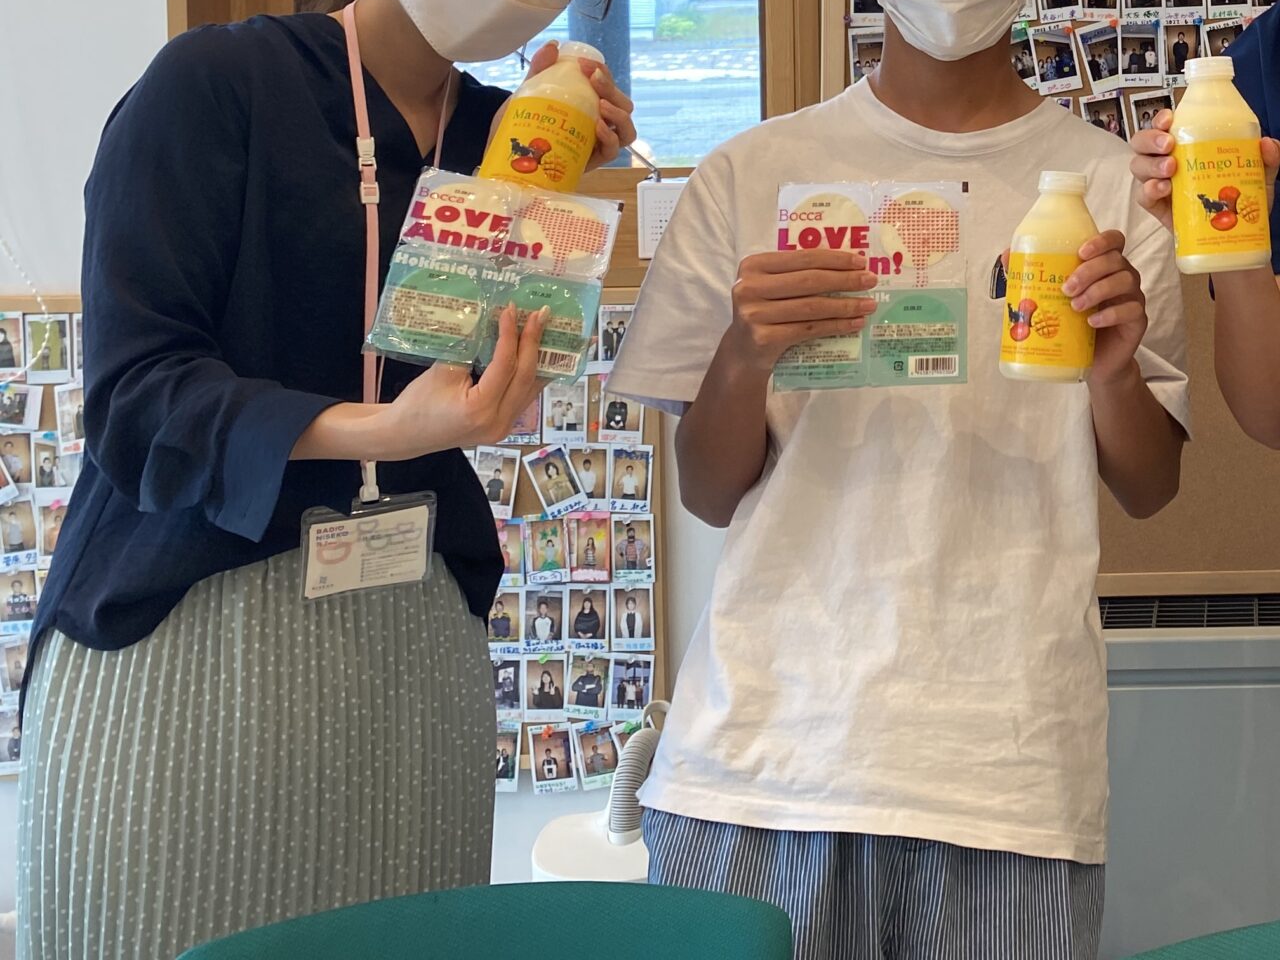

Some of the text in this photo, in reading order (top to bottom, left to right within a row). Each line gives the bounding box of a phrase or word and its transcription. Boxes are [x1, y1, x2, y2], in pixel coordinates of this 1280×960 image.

[512, 109, 589, 145] Mango Lassi
[1186, 158, 1232, 172] Mango
[417, 187, 465, 205] Bocca
[410, 201, 513, 234] LOVE
[779, 209, 824, 222] Bocca
[403, 222, 544, 260] Annin!
[777, 226, 870, 251] LOVE
[395, 252, 478, 279] Hokkaido
[482, 265, 522, 285] milk
[316, 525, 345, 535] RADIO
